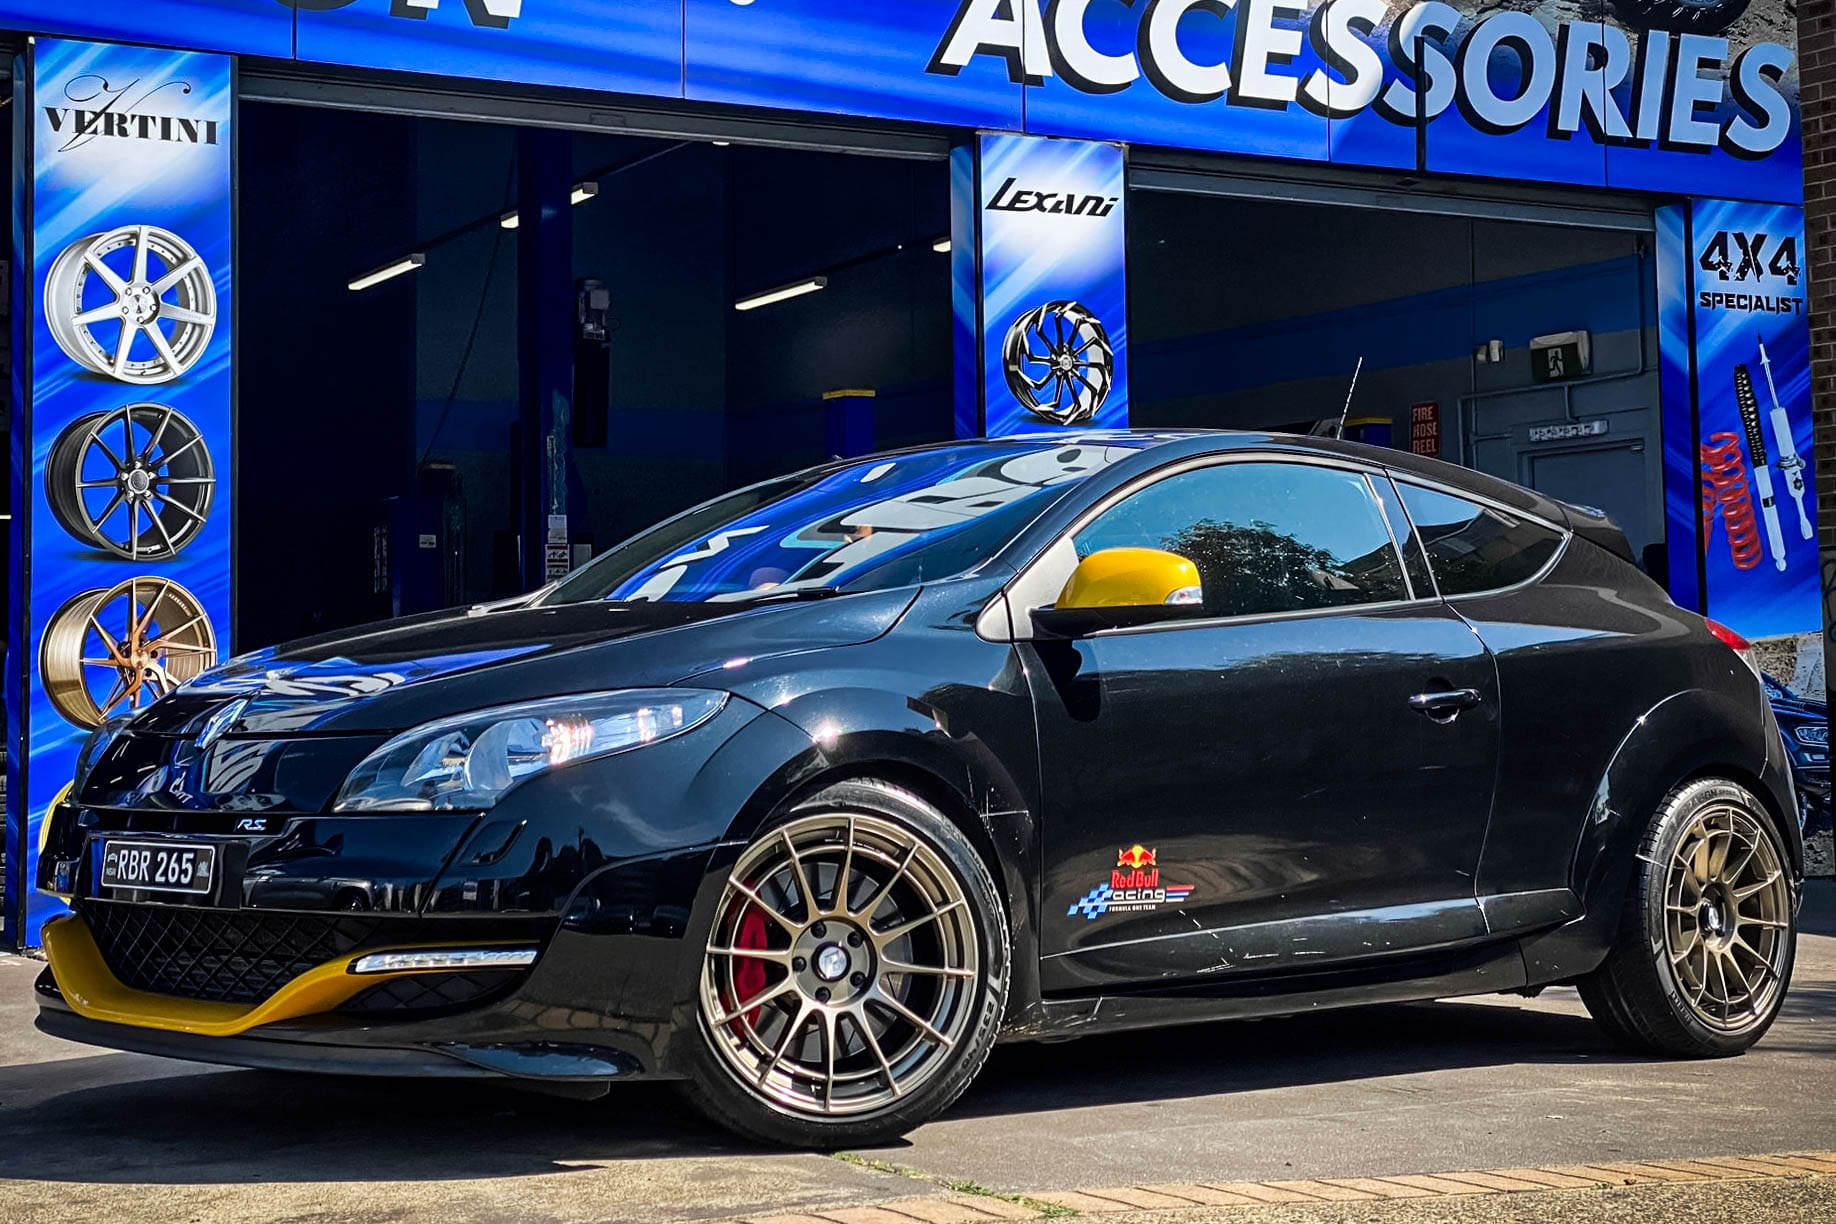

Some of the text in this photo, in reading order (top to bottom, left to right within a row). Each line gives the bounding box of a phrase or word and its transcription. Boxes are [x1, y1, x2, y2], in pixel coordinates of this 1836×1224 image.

[930, 0, 1792, 153] ACCESSORIES
[43, 106, 219, 146] VERTINI
[1699, 291, 1803, 315] SPECIALIST
[1412, 406, 1434, 422] FIRE
[117, 849, 195, 884] RBR 265
[1111, 867, 1159, 889] Red Bull
